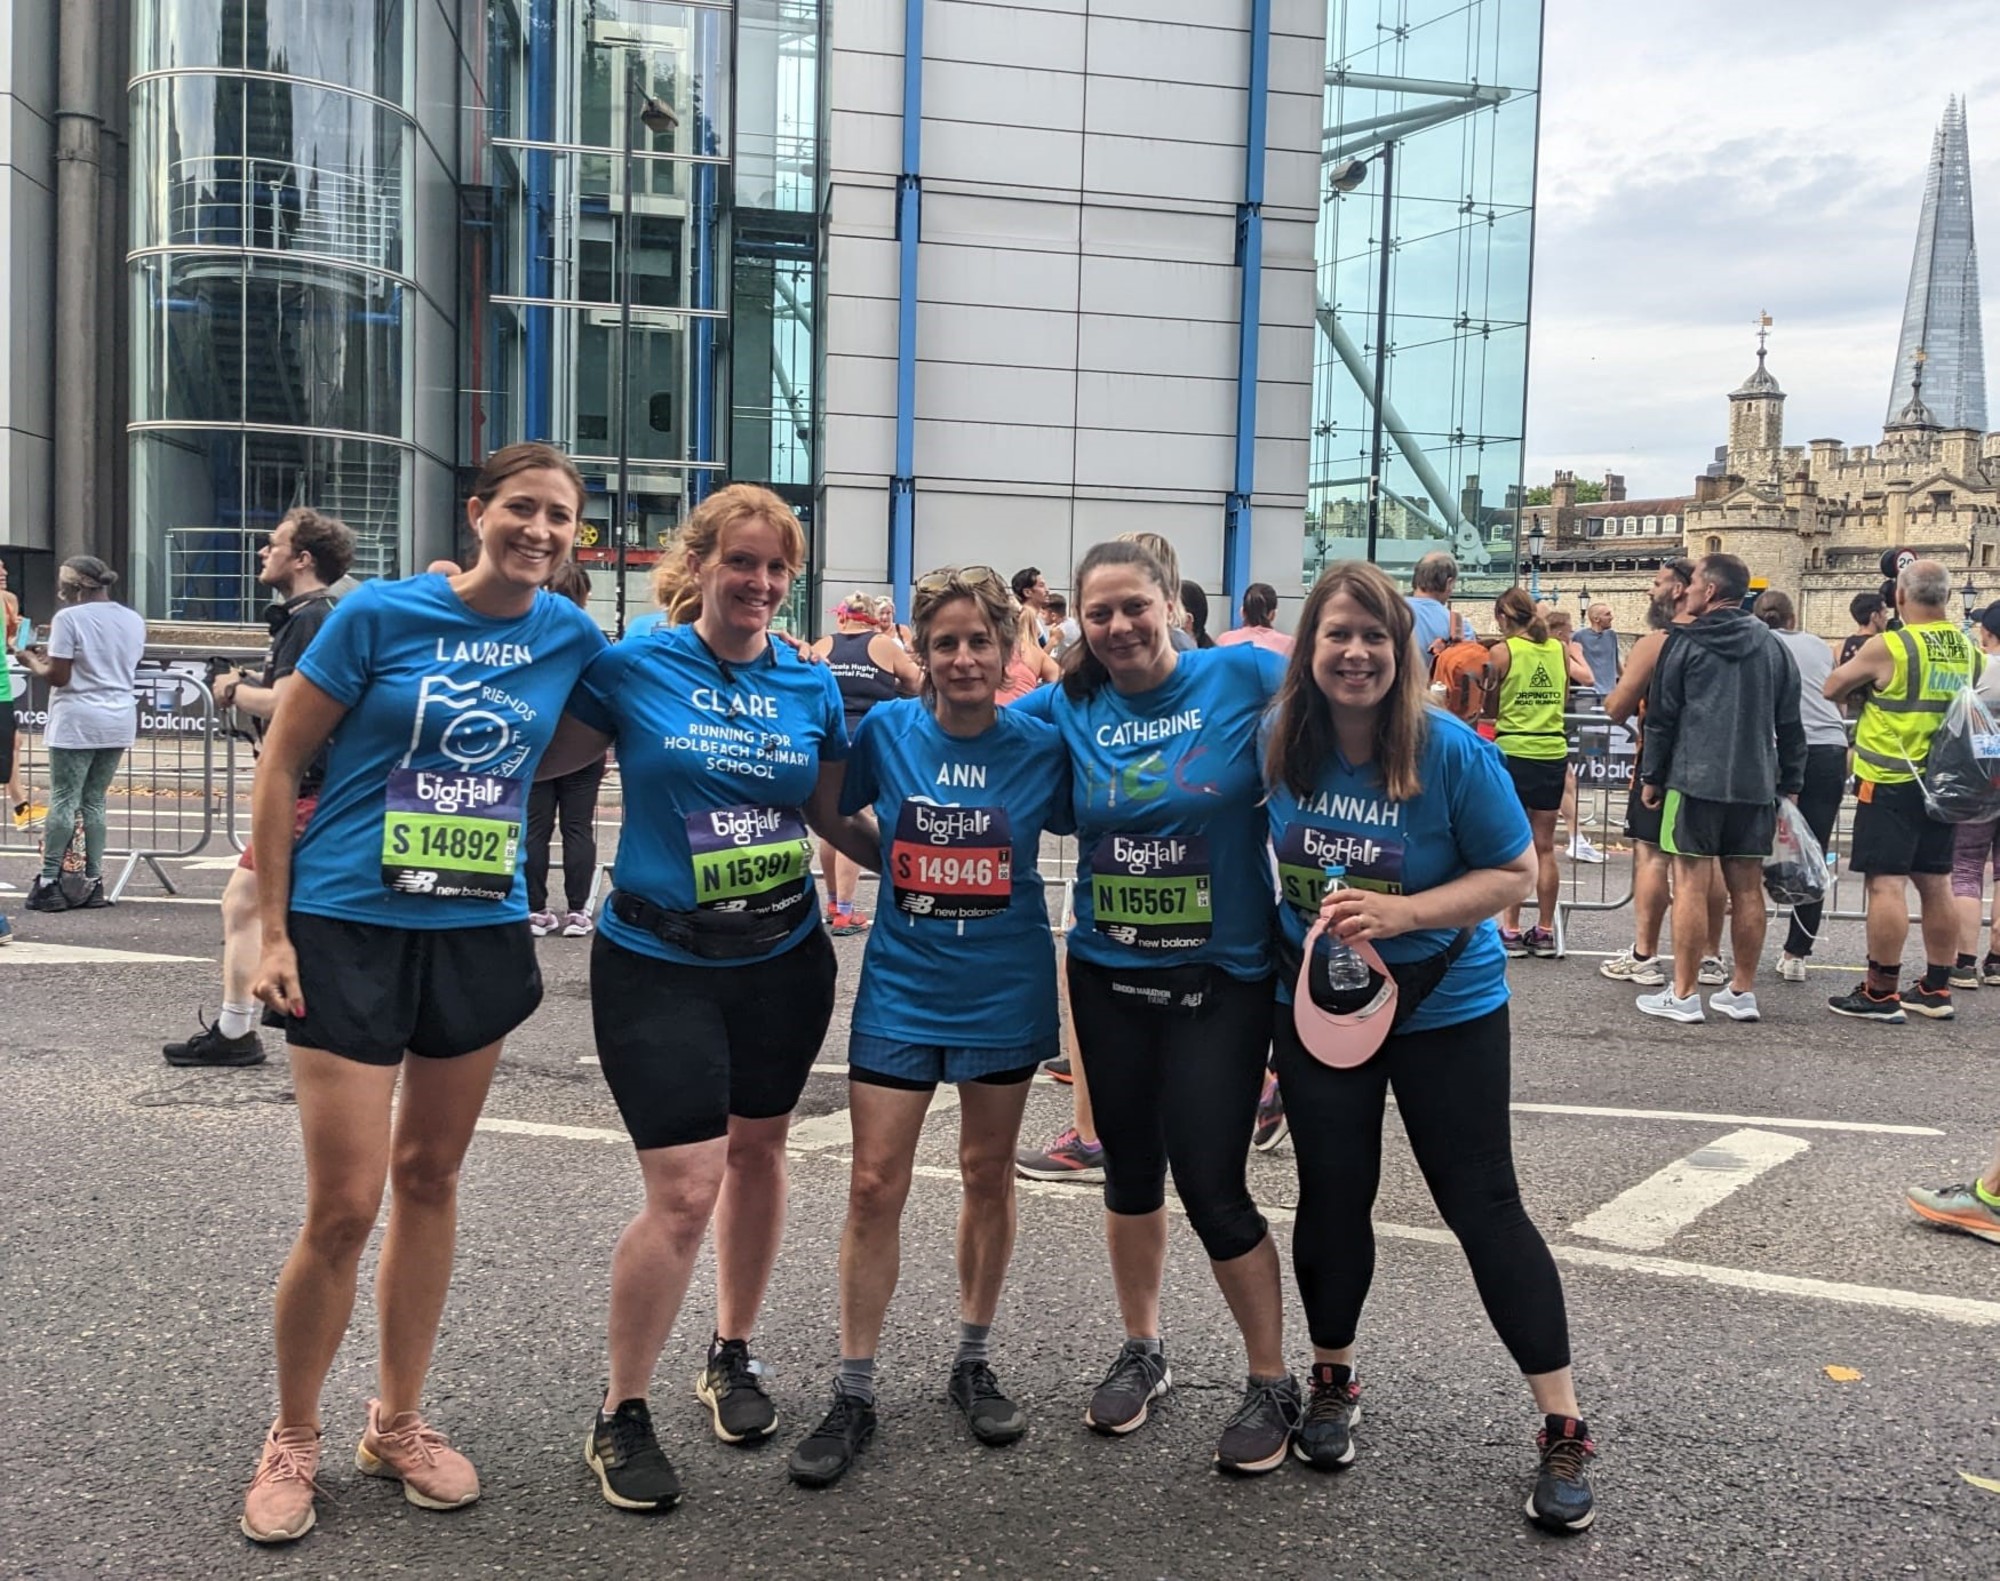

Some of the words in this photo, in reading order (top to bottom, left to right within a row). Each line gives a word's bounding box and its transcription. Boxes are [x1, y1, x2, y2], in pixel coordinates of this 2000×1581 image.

[436, 637, 533, 667] LAUREN
[829, 663, 850, 671] icola
[851, 663, 879, 673] Hughes
[855, 671, 875, 679] Fund
[692, 688, 779, 719] CLARE
[1515, 691, 1561, 699] ORPINGTO
[689, 723, 755, 743] RUNNING
[760, 733, 791, 747] FOR
[1096, 708, 1203, 747] CATHERINE
[664, 736, 750, 758] HOLBEACH
[756, 749, 810, 766] PRIMARY
[706, 757, 776, 779] SCHOOL
[936, 762, 987, 788] ANN
[1591, 760, 1636, 778] bala
[1297, 791, 1400, 827] HANNAH
[392, 824, 411, 854] S
[421, 825, 499, 862] 14892
[702, 864, 720, 892] N
[726, 851, 791, 887] 15391
[898, 853, 911, 879] S
[918, 855, 992, 886] 14946
[436, 886, 462, 896] new
[462, 886, 506, 900] balance
[1285, 875, 1300, 898] S
[750, 906, 771, 914] ew
[771, 893, 803, 912] balance
[935, 907, 958, 917] new
[959, 907, 1007, 917] balanc
[1098, 885, 1113, 912] N
[1119, 887, 1187, 915] 15567
[1138, 938, 1160, 948] new
